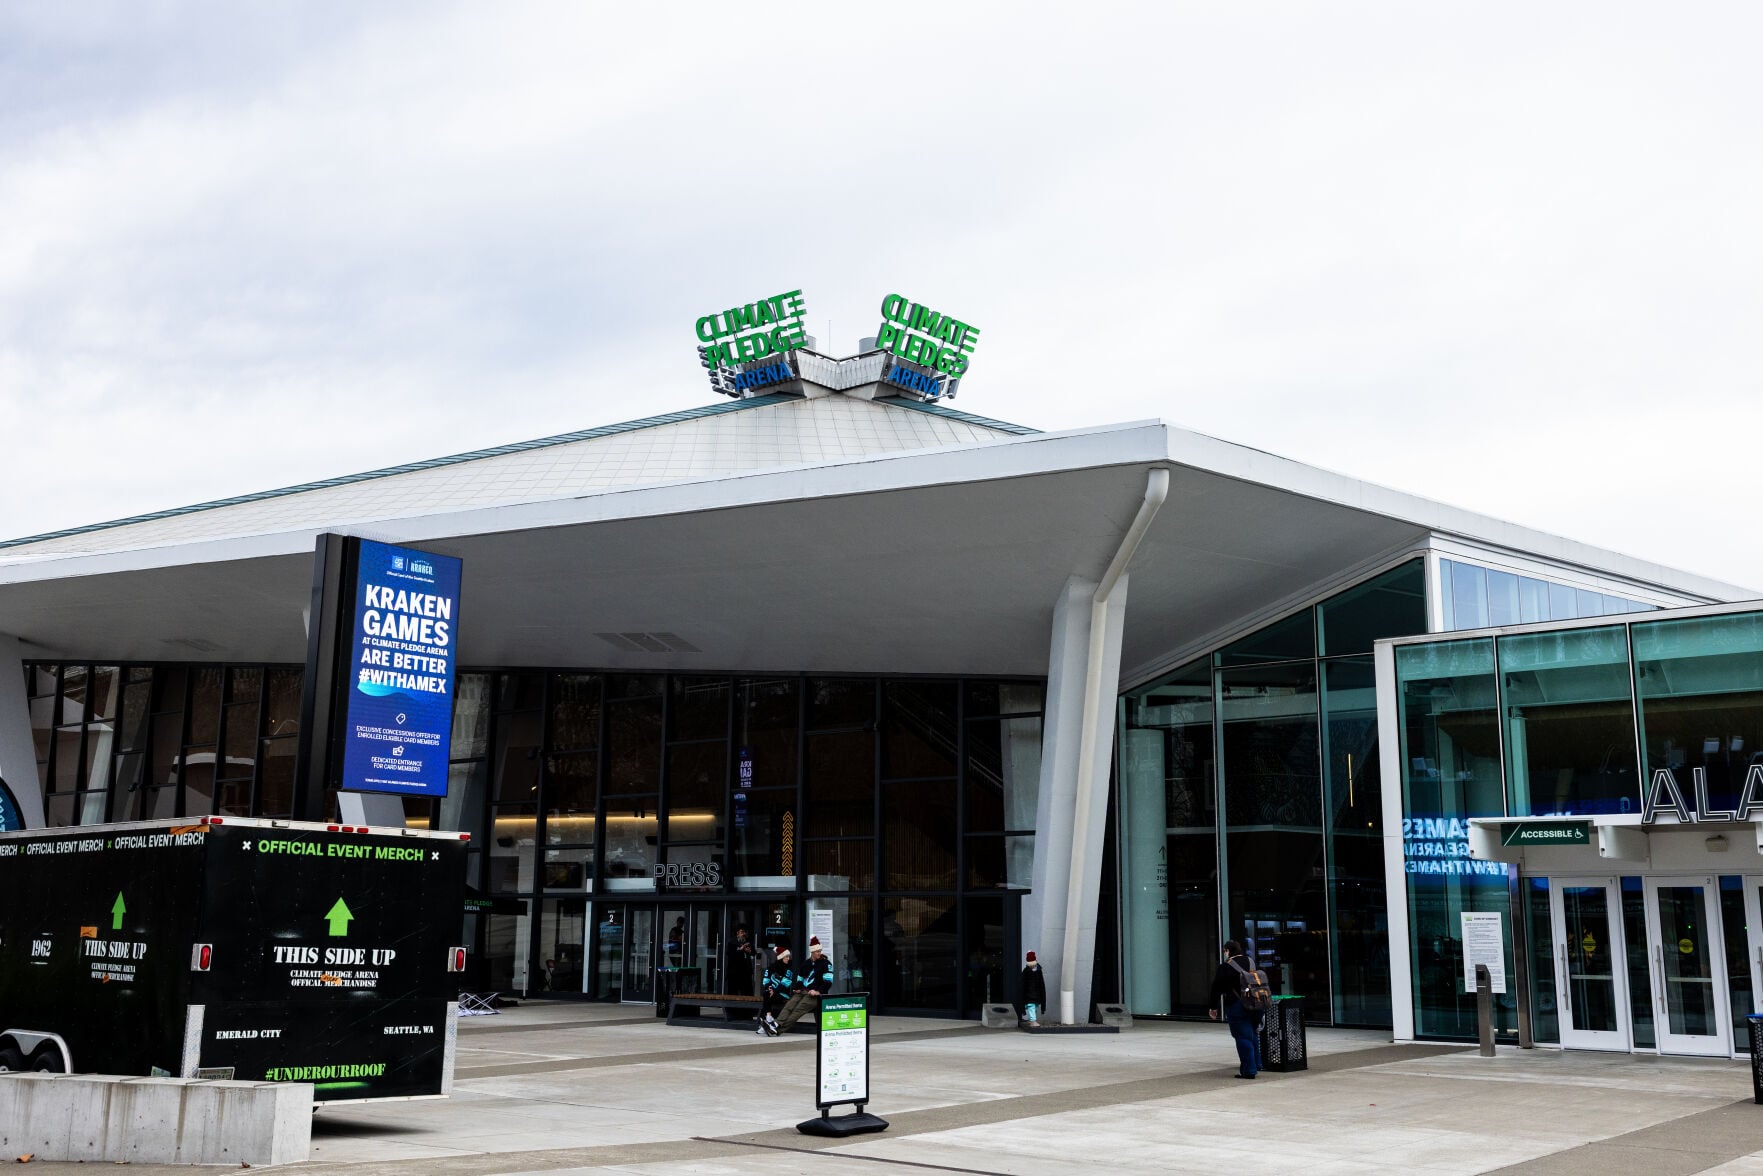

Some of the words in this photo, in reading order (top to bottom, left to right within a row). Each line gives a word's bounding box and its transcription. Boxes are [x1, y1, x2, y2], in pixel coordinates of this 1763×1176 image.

[695, 288, 807, 343] CLIMATE
[881, 293, 980, 353] CLIMATE
[706, 321, 808, 371] PLEDGE
[875, 322, 968, 379] PLEDGE
[735, 361, 793, 391] ARENA
[888, 365, 939, 396] ARENA
[365, 584, 451, 620] KRAKEN
[363, 609, 449, 647] GAMES
[362, 636, 372, 645] AT
[372, 637, 400, 650] CLIMATE
[401, 641, 426, 653] PLEDGE
[426, 644, 448, 656] ARENA
[361, 648, 390, 667] ARE
[393, 652, 446, 674] BETTER
[358, 667, 446, 694] #WITHAMEX
[356, 725, 382, 734] EXCLUSIVE
[382, 728, 416, 737] CONCESSIONS
[416, 731, 431, 739] OFFER
[357, 732, 382, 740] ENROLLED
[417, 738, 440, 746] MEMBERS
[371, 756, 397, 765] DEDICATED
[397, 758, 423, 767] ENTRANCE
[397, 765, 421, 773] MEMBERS
[26, 842, 56, 855] OFFICIAL
[56, 841, 78, 854] EVENT
[78, 839, 104, 853] MERCH
[114, 835, 147, 850] OFFICIAL
[148, 834, 175, 848] EVENT
[174, 832, 205, 846] MERCH
[1520, 830, 1572, 839] ACCESSIBLE
[258, 839, 324, 856] OFFICIAL
[327, 843, 373, 859] EVENT
[375, 845, 424, 861] MERCH
[653, 862, 720, 886] PRESS
[609, 914, 614, 923] 2
[776, 914, 782, 924] 2
[31, 940, 52, 957] 1962
[85, 940, 107, 957] THIS
[108, 941, 130, 959] SIDE
[132, 942, 147, 960] UP
[274, 946, 319, 964] THIS
[324, 947, 366, 965] SIDE
[372, 949, 396, 966] UP
[290, 969, 323, 978] CLIMATE
[325, 970, 353, 979] PLEDGE
[354, 971, 379, 979] ARENA
[216, 1028, 258, 1040] EMERALD
[260, 1029, 282, 1040] CITY
[383, 1026, 420, 1036] SEATTLE,
[422, 1025, 434, 1034] WA
[265, 1063, 386, 1082] #UNDEROURROOF
